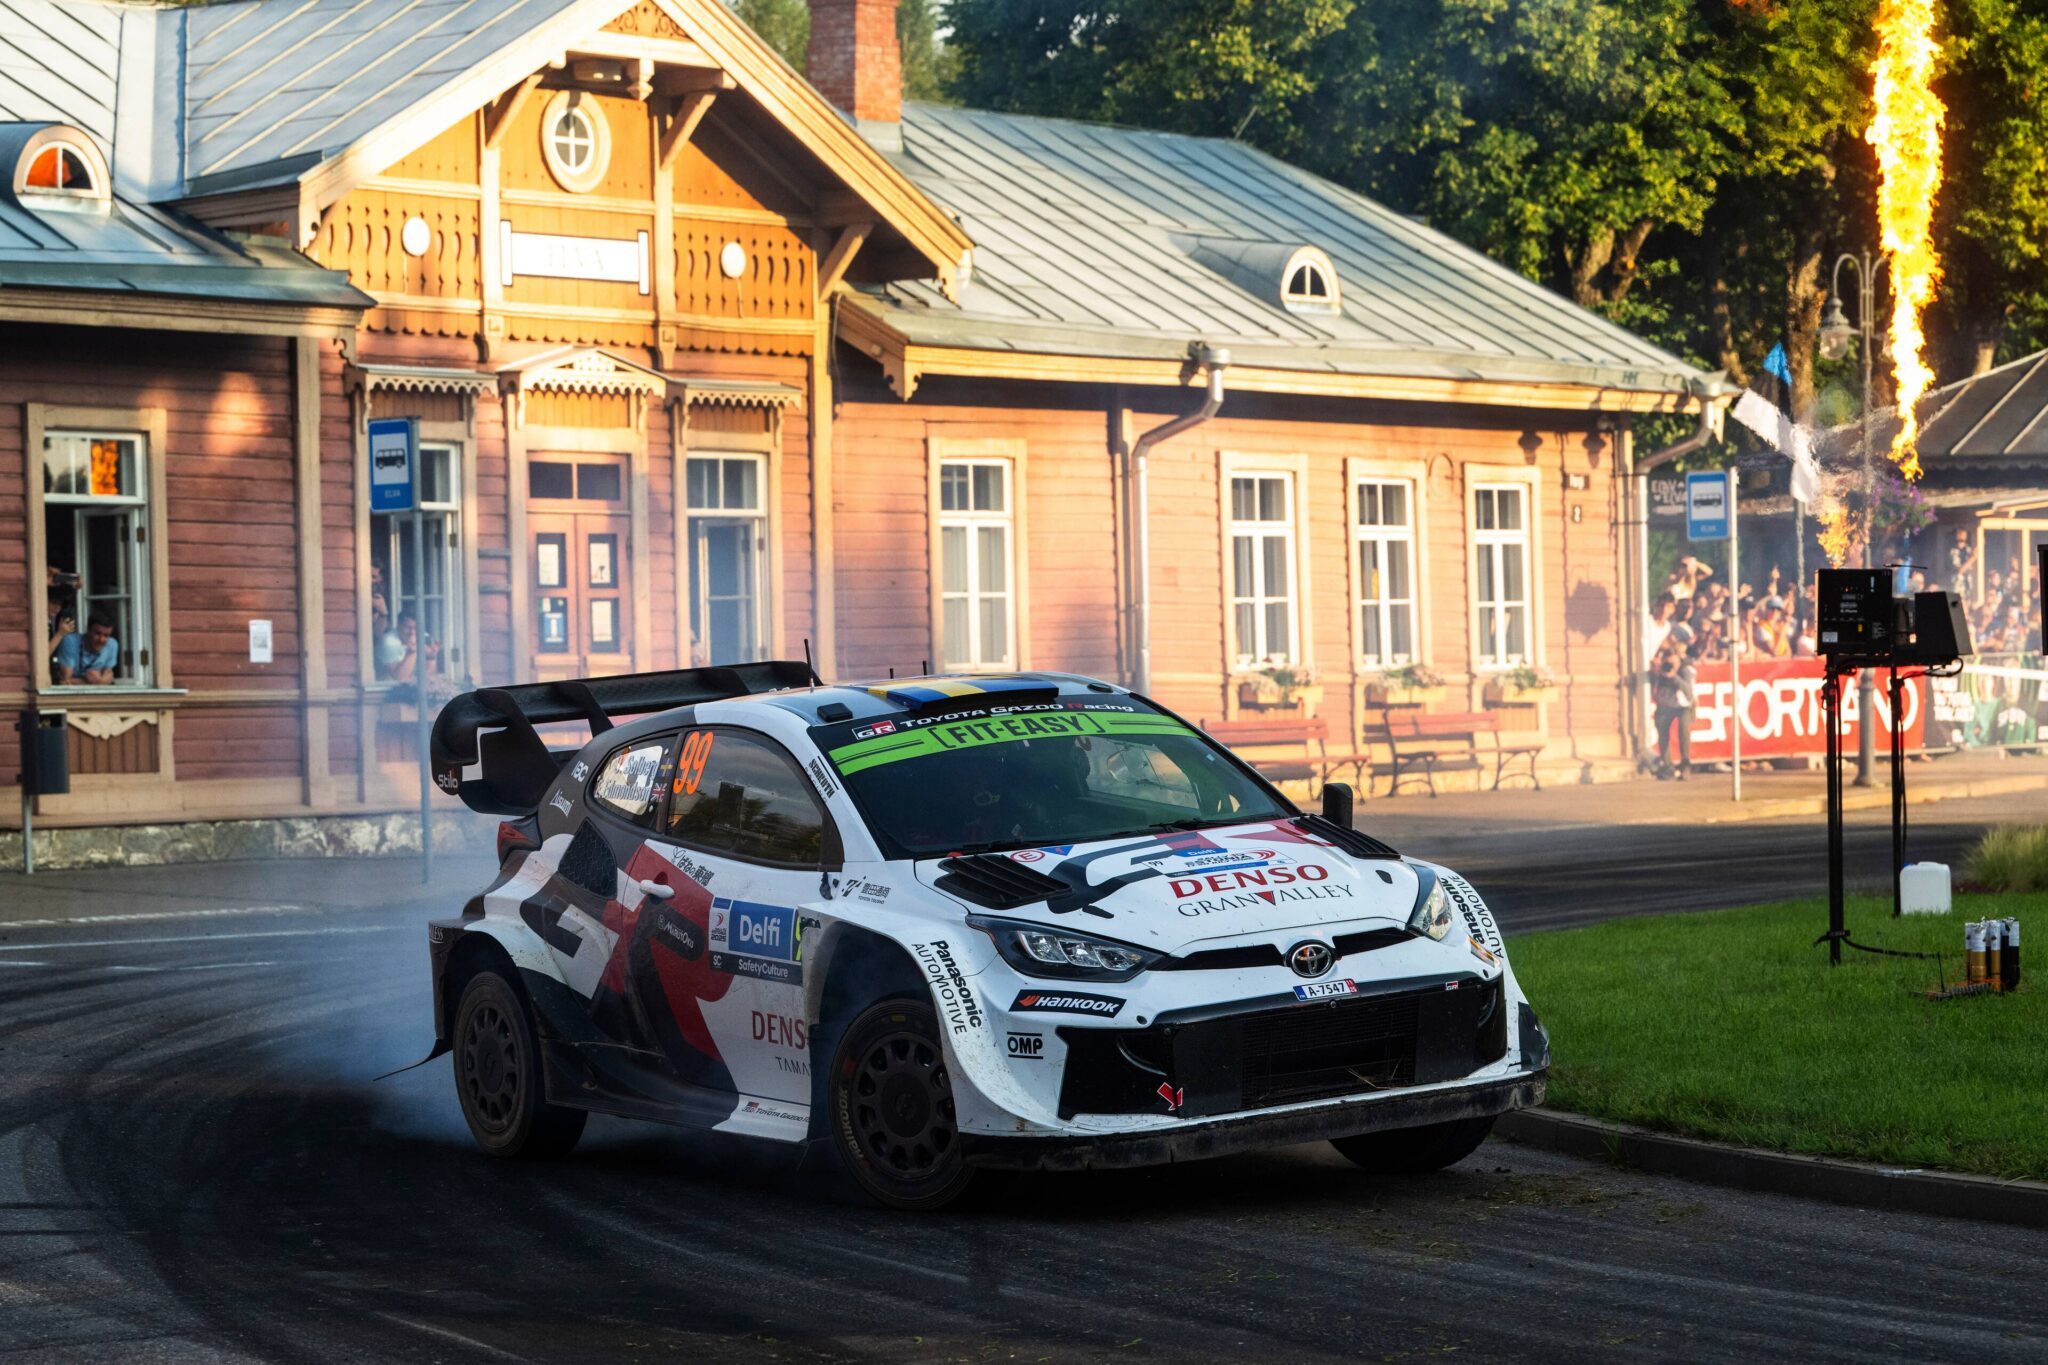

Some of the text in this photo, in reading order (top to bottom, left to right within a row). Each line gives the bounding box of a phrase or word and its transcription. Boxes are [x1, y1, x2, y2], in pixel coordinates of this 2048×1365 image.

[857, 725, 894, 739] GR
[900, 708, 986, 727] TOYOTA
[990, 704, 1063, 714] GAZOO
[438, 770, 458, 788] Stilo
[673, 731, 714, 795] 99
[1168, 864, 1328, 899] DENSO
[1441, 877, 1485, 945] anasonic
[1448, 875, 1504, 959] AUTOMOTIVE
[740, 914, 781, 947] Delfi
[738, 959, 788, 978] SafetyCulture
[929, 940, 983, 1029] Panasonic
[911, 943, 968, 1036] AUTOMOTIVE
[1308, 982, 1345, 997] A-7547
[752, 1010, 809, 1050] DENS
[1007, 1037, 1043, 1055] OMP
[775, 1056, 811, 1076] TAMA
